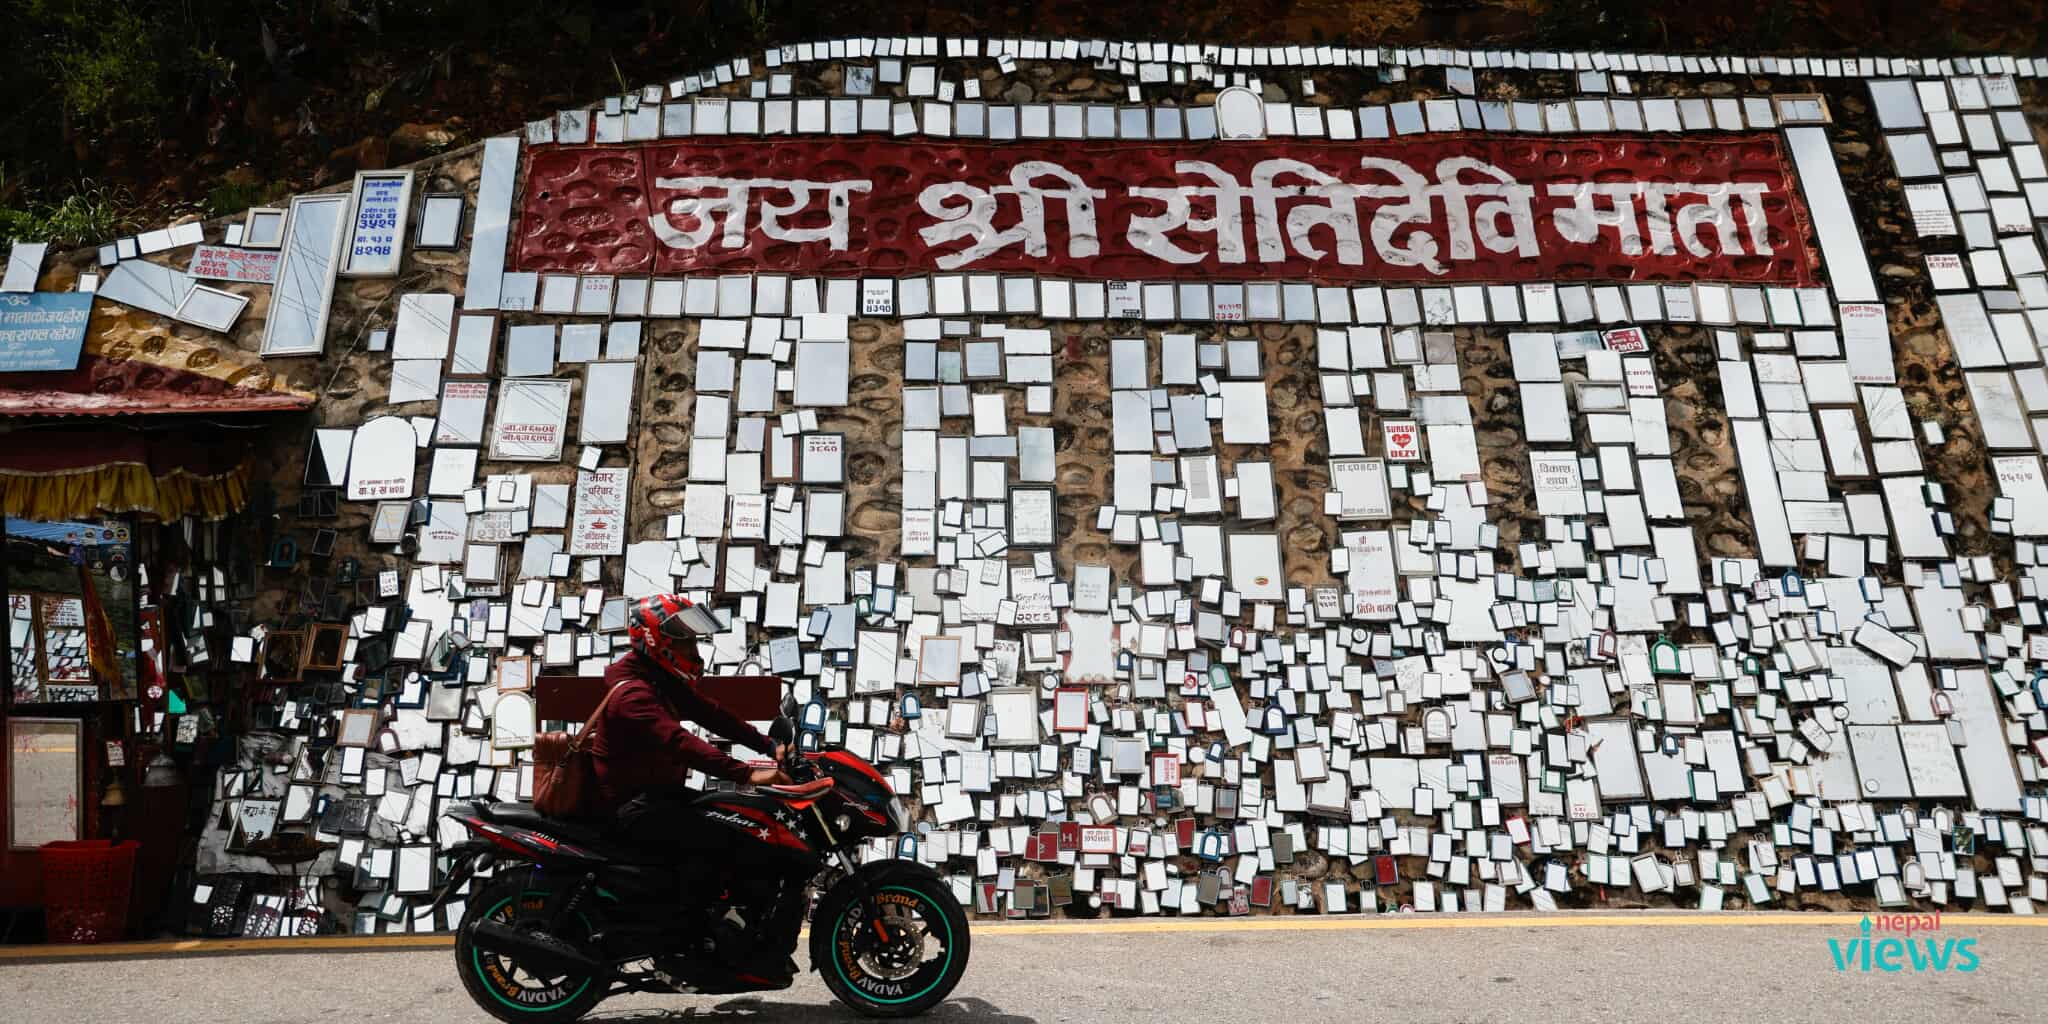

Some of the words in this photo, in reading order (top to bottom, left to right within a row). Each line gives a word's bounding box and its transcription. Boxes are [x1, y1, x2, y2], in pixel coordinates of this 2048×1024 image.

[649, 176, 872, 251] जय
[917, 160, 1105, 270] श्री
[1551, 182, 1774, 257] माता
[355, 246, 391, 256] ४२१४
[1387, 426, 1415, 436] SURESH
[587, 485, 614, 497] परिवार
[875, 892, 919, 908] Brand
[837, 940, 862, 981] Brand
[484, 962, 519, 998] Brand
[857, 975, 904, 997] YADAV
[518, 989, 568, 1004] YADAV
